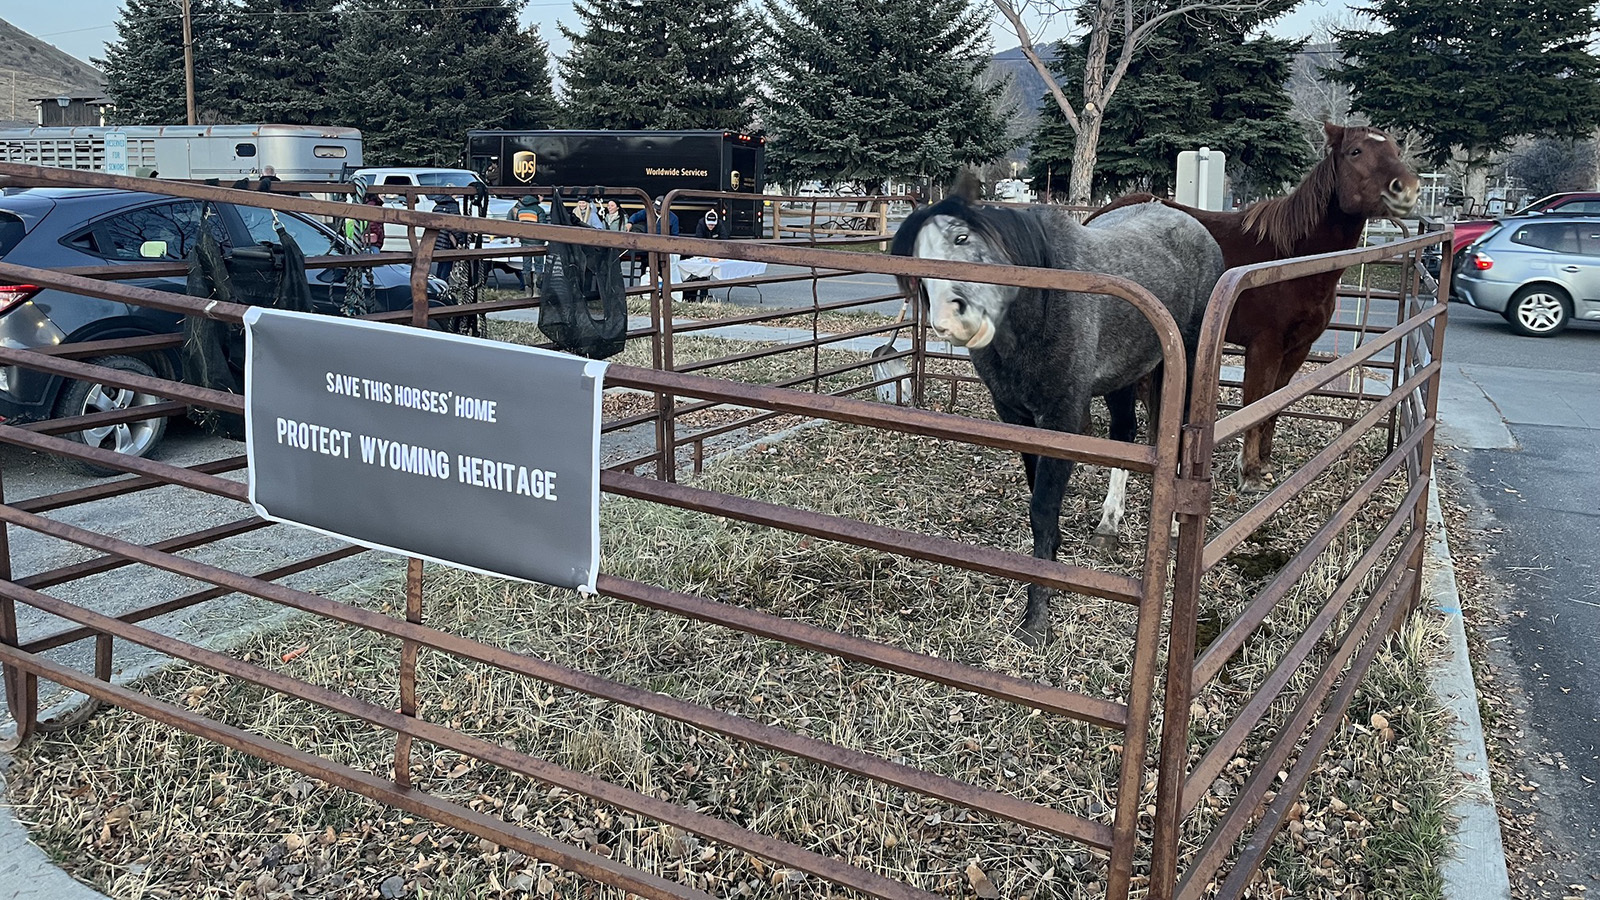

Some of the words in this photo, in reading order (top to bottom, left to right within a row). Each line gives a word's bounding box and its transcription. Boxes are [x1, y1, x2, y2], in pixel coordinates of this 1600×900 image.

[645, 167, 680, 176] Worldwide
[681, 167, 708, 177] Services
[326, 372, 361, 398] SAVE
[362, 378, 393, 404] THIS
[394, 384, 453, 415] HORSES'
[455, 395, 497, 423] HOME
[277, 417, 352, 459] PROTECT
[360, 434, 450, 480] WYOMING
[458, 454, 558, 502] HERITAGE
